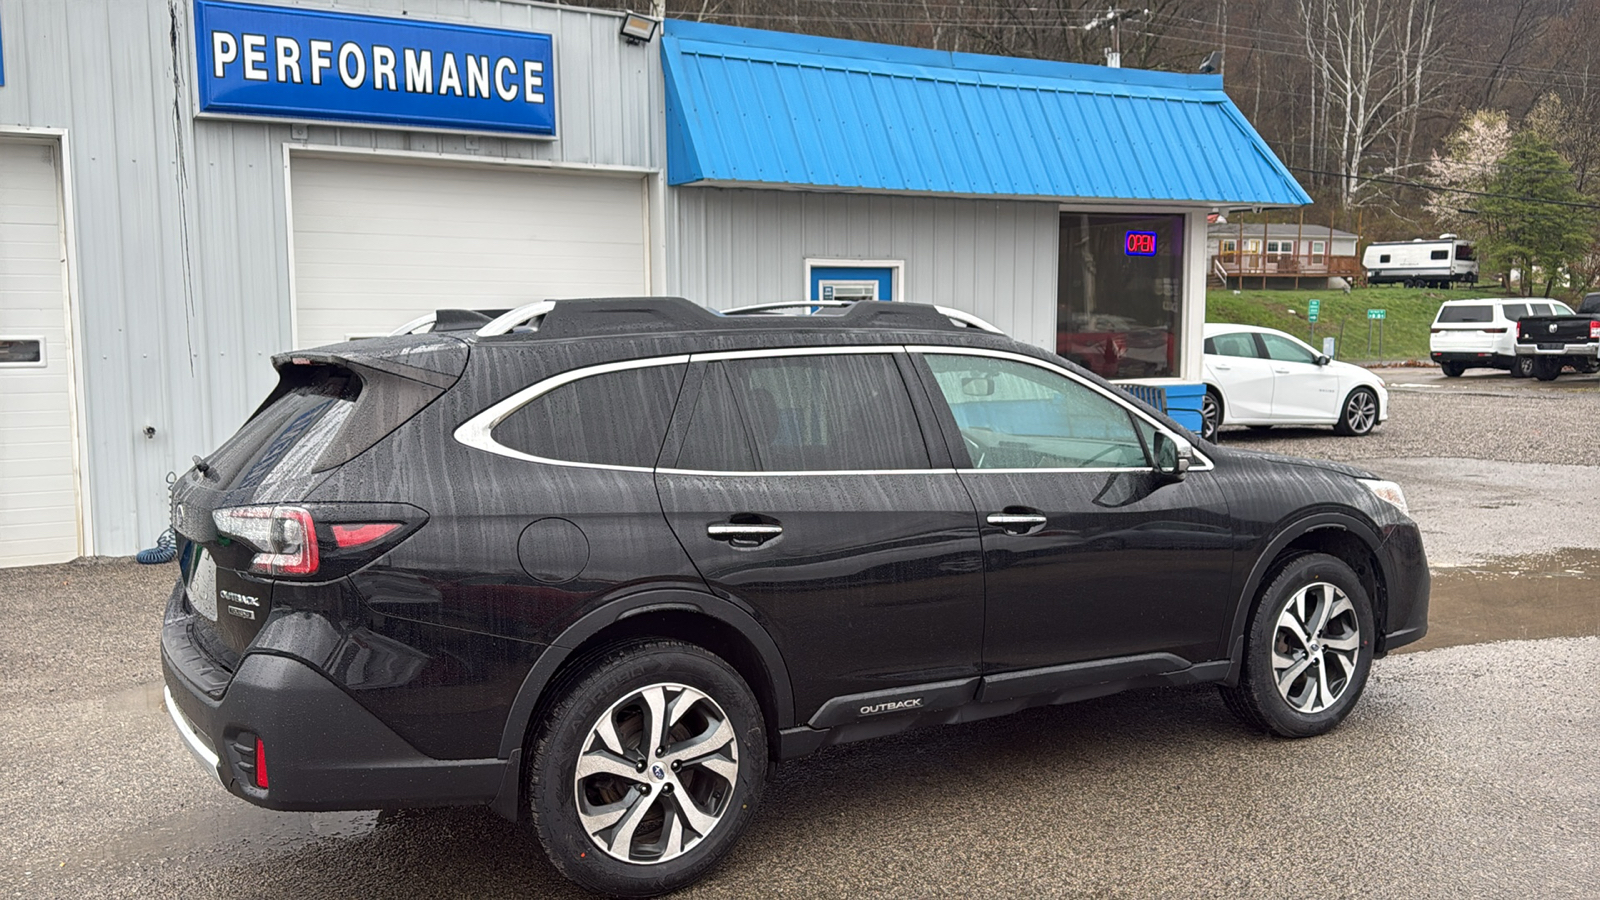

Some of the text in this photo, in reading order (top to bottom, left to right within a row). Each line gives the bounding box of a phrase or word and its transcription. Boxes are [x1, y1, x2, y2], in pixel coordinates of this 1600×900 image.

[212, 31, 545, 104] PERFORMANCE
[1127, 234, 1155, 252] OPEN
[220, 590, 260, 607] OUTBACK
[860, 698, 921, 714] OUTBACK
